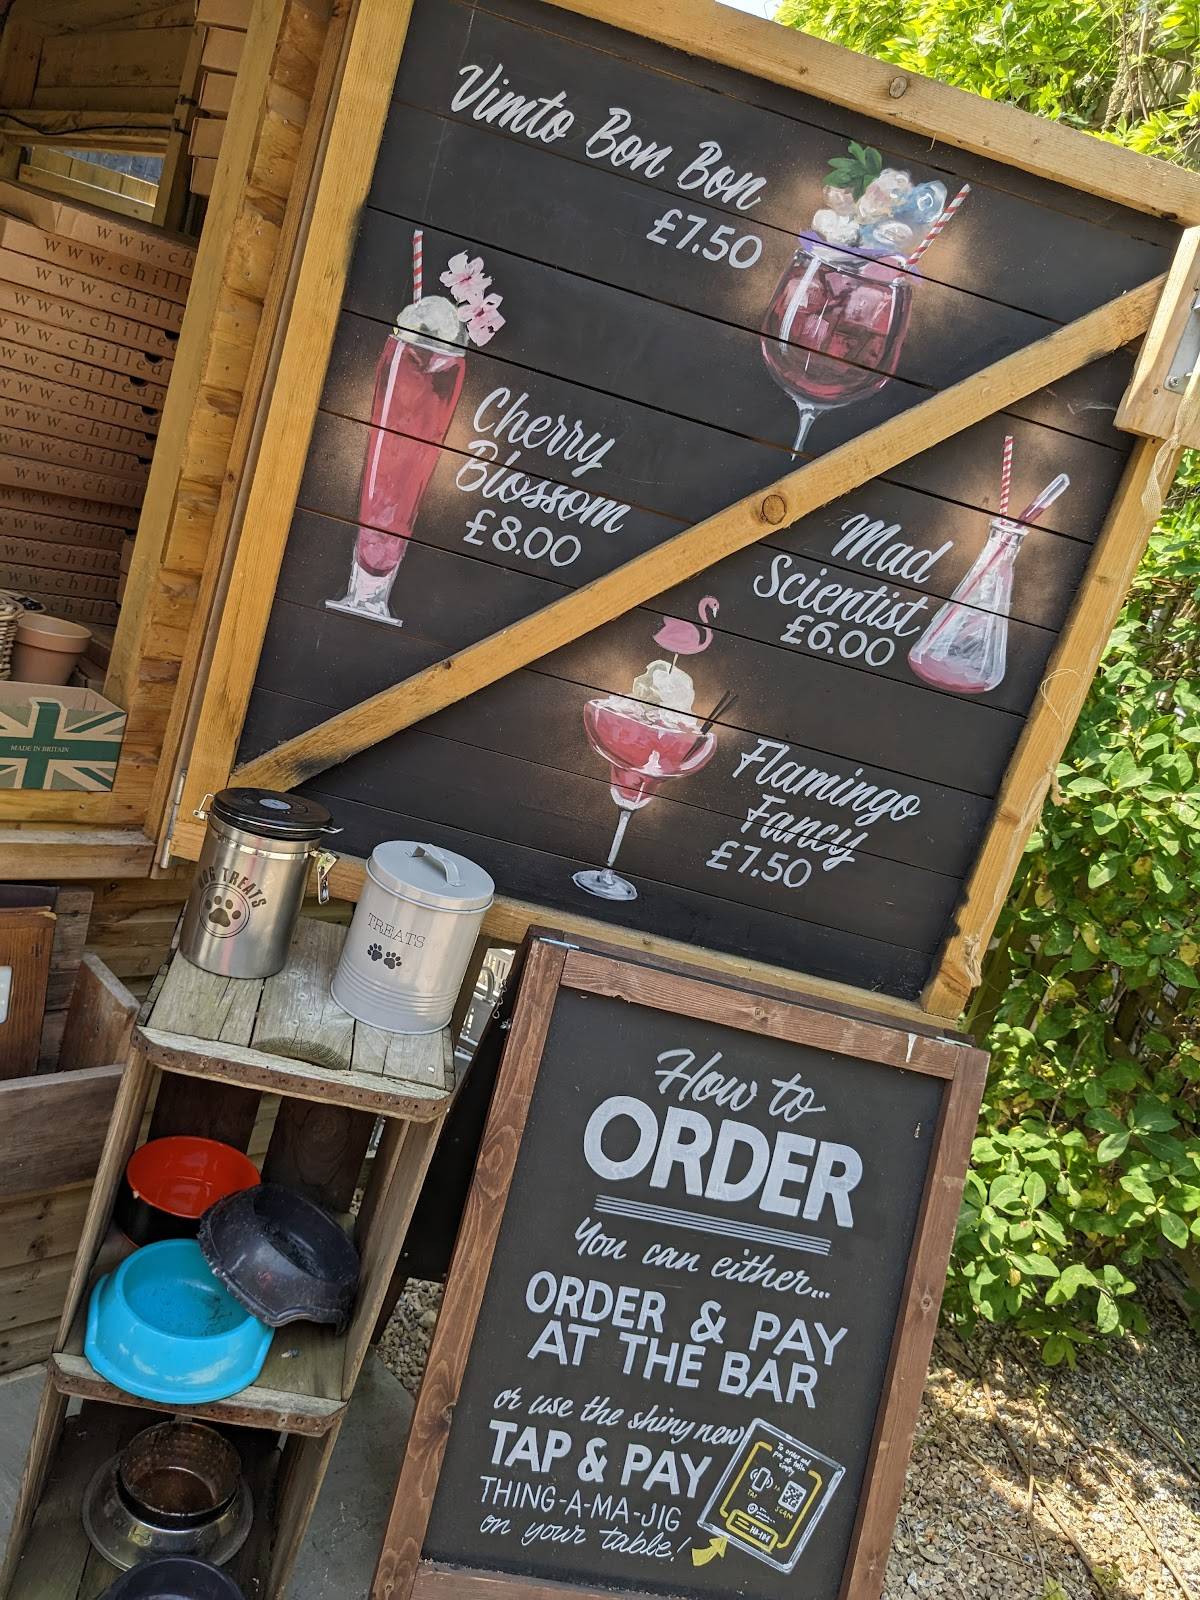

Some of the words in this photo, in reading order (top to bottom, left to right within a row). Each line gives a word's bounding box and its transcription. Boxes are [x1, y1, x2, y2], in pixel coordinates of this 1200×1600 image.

[451, 63, 575, 143] Vimto
[586, 107, 672, 178] Bon
[677, 140, 767, 210] Bon
[646, 208, 763, 269] £7.50
[473, 387, 615, 477] Cherry
[456, 439, 631, 533] Blossom
[463, 509, 582, 567] £8.00
[831, 513, 954, 583] Mad
[753, 554, 928, 636] Scientist
[780, 615, 895, 666] £6.00
[42, 745, 70, 753] BRITAIN
[732, 738, 921, 827] Flamingo
[705, 840, 812, 888] £7.50
[741, 794, 869, 872] Fancy
[222, 867, 267, 908] TREATS
[367, 912, 426, 949] TREATS
[655, 1048, 757, 1111] How
[768, 1073, 826, 1122] to
[584, 1095, 863, 1228] ORDER
[574, 1216, 627, 1259] You
[642, 1244, 701, 1272] can
[711, 1249, 830, 1299] either...
[525, 1270, 667, 1333] ORDER
[690, 1300, 727, 1344] &
[749, 1311, 848, 1366] PAY
[527, 1320, 600, 1366] AT
[619, 1331, 706, 1388] THE
[718, 1351, 819, 1409] BAR
[493, 1387, 523, 1410] or
[528, 1395, 573, 1417] use
[580, 1395, 624, 1426] the
[628, 1404, 696, 1445] shiny
[693, 1421, 745, 1446] new
[489, 1419, 572, 1473] TAP
[577, 1437, 607, 1483] &
[620, 1443, 713, 1498] PAY
[480, 1475, 682, 1532] THING-A-MA-JIG
[480, 1514, 511, 1534] on
[522, 1521, 587, 1546] your
[599, 1526, 692, 1562] table!
